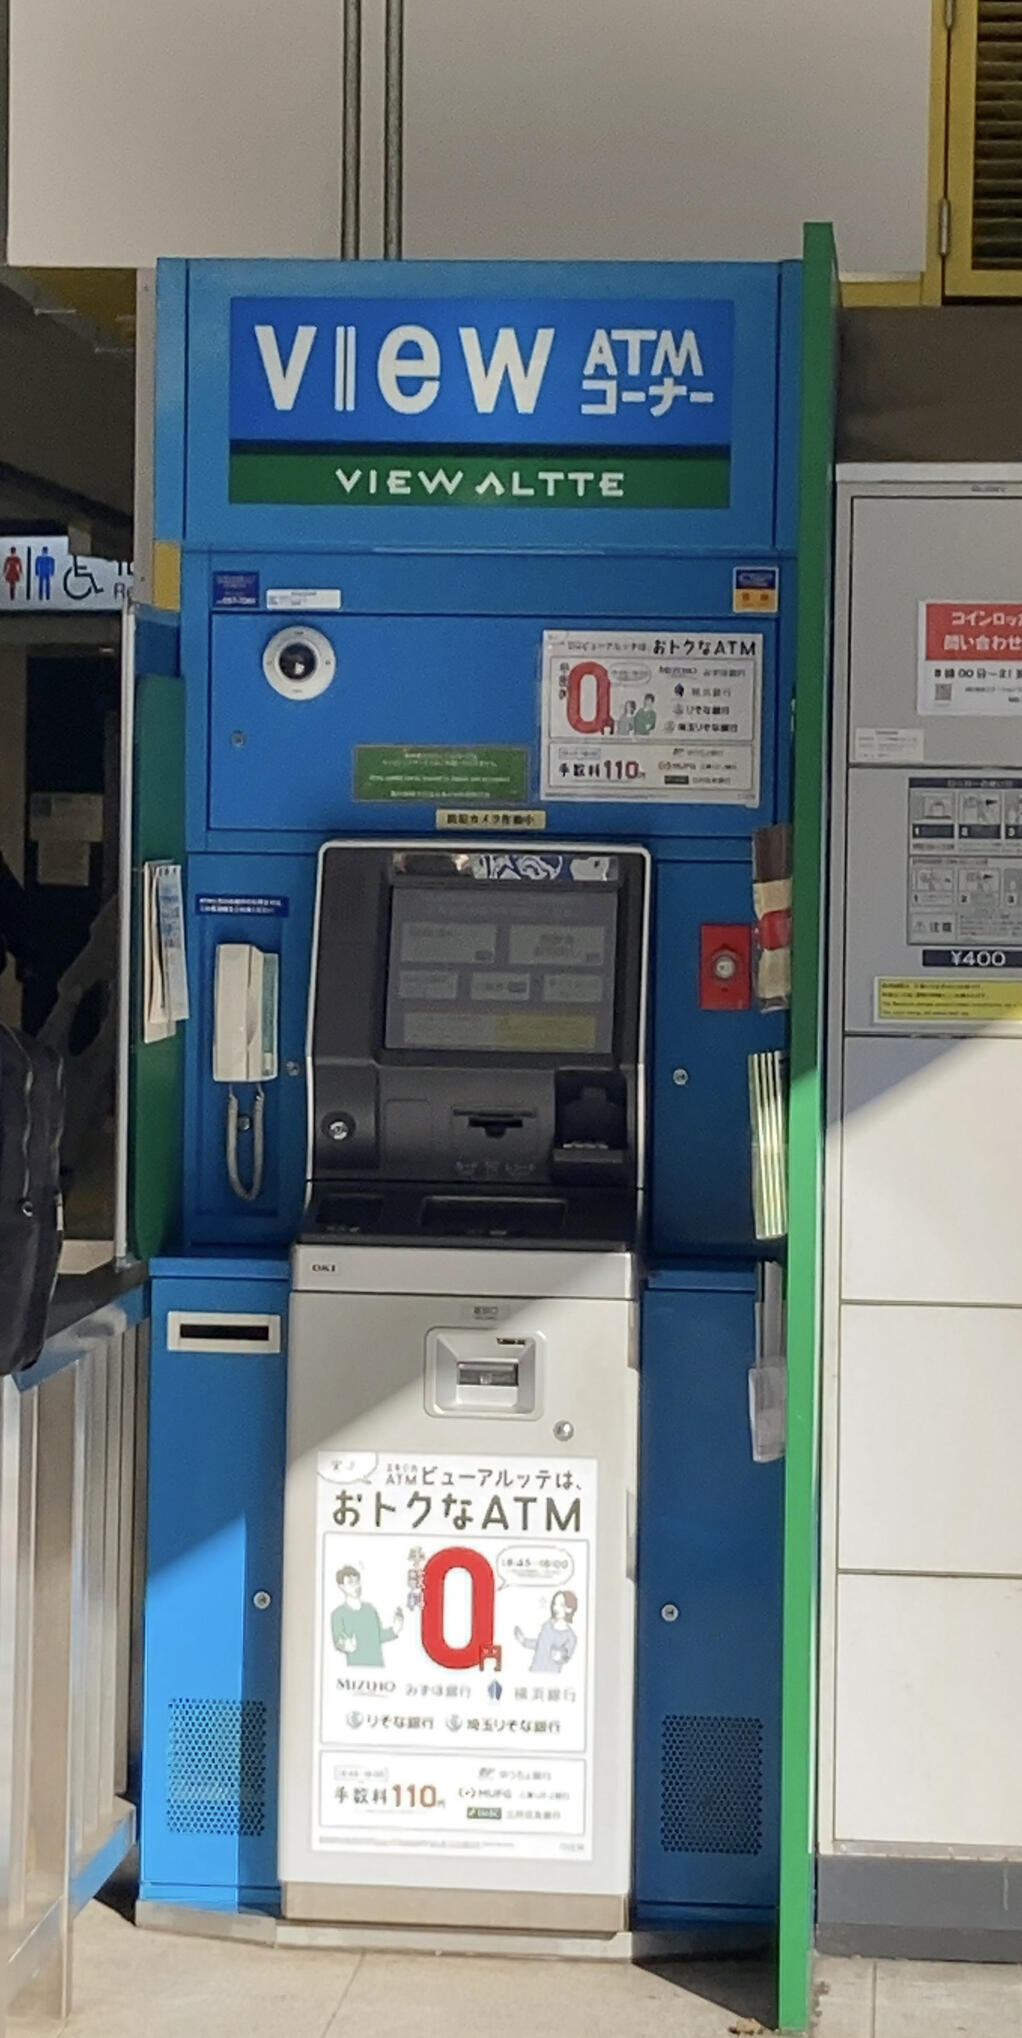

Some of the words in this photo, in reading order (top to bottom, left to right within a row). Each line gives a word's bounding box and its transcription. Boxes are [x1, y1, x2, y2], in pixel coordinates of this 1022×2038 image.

[583, 328, 704, 377] ATM
[580, 378, 714, 417] コーナー
[335, 469, 464, 495] VIEW
[653, 638, 756, 656] おトクなATM
[951, 950, 1006, 966] ¥400
[333, 1489, 582, 1532] おトクなATM
[366, 1713, 435, 1730] りそな銀行
[466, 1717, 561, 1734] 埼玉りそな銀行
